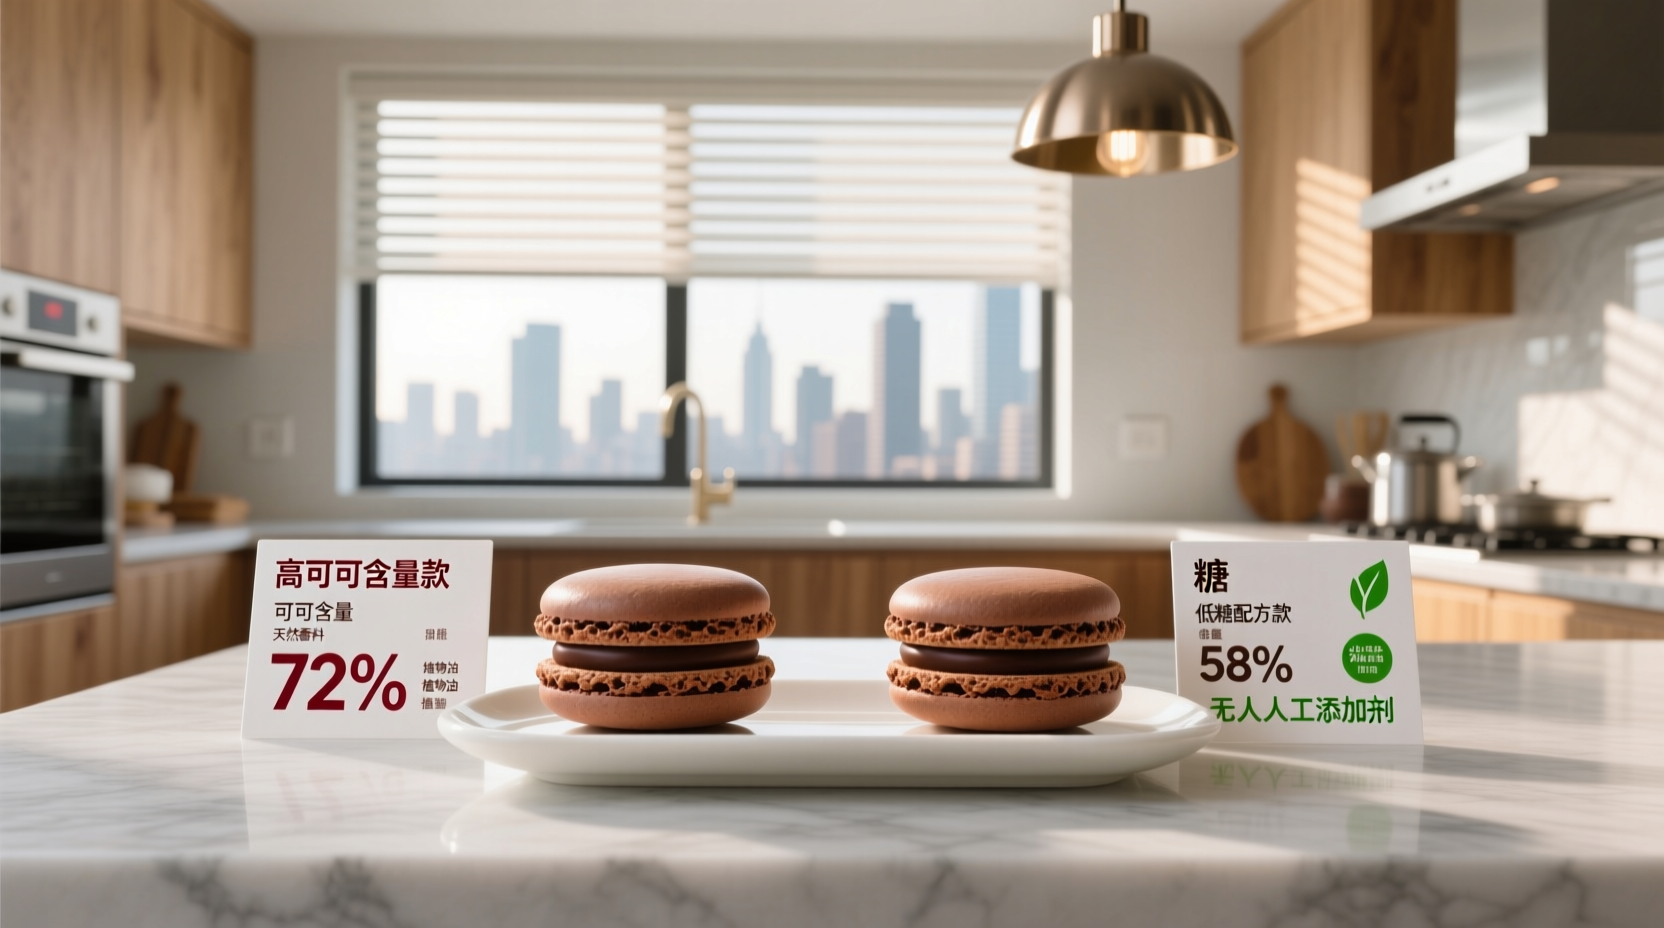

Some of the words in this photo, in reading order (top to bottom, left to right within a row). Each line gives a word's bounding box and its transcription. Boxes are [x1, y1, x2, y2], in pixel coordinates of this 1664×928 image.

[275, 558, 450, 589] 高可可含量款
[1194, 558, 1229, 593] 糖
[274, 601, 354, 622] 可可含量
[1195, 603, 1292, 624] 低糖配方款
[1200, 645, 1293, 683] 58%
[271, 652, 407, 712] 72%
[1210, 695, 1394, 724] 无人人工添加剂
